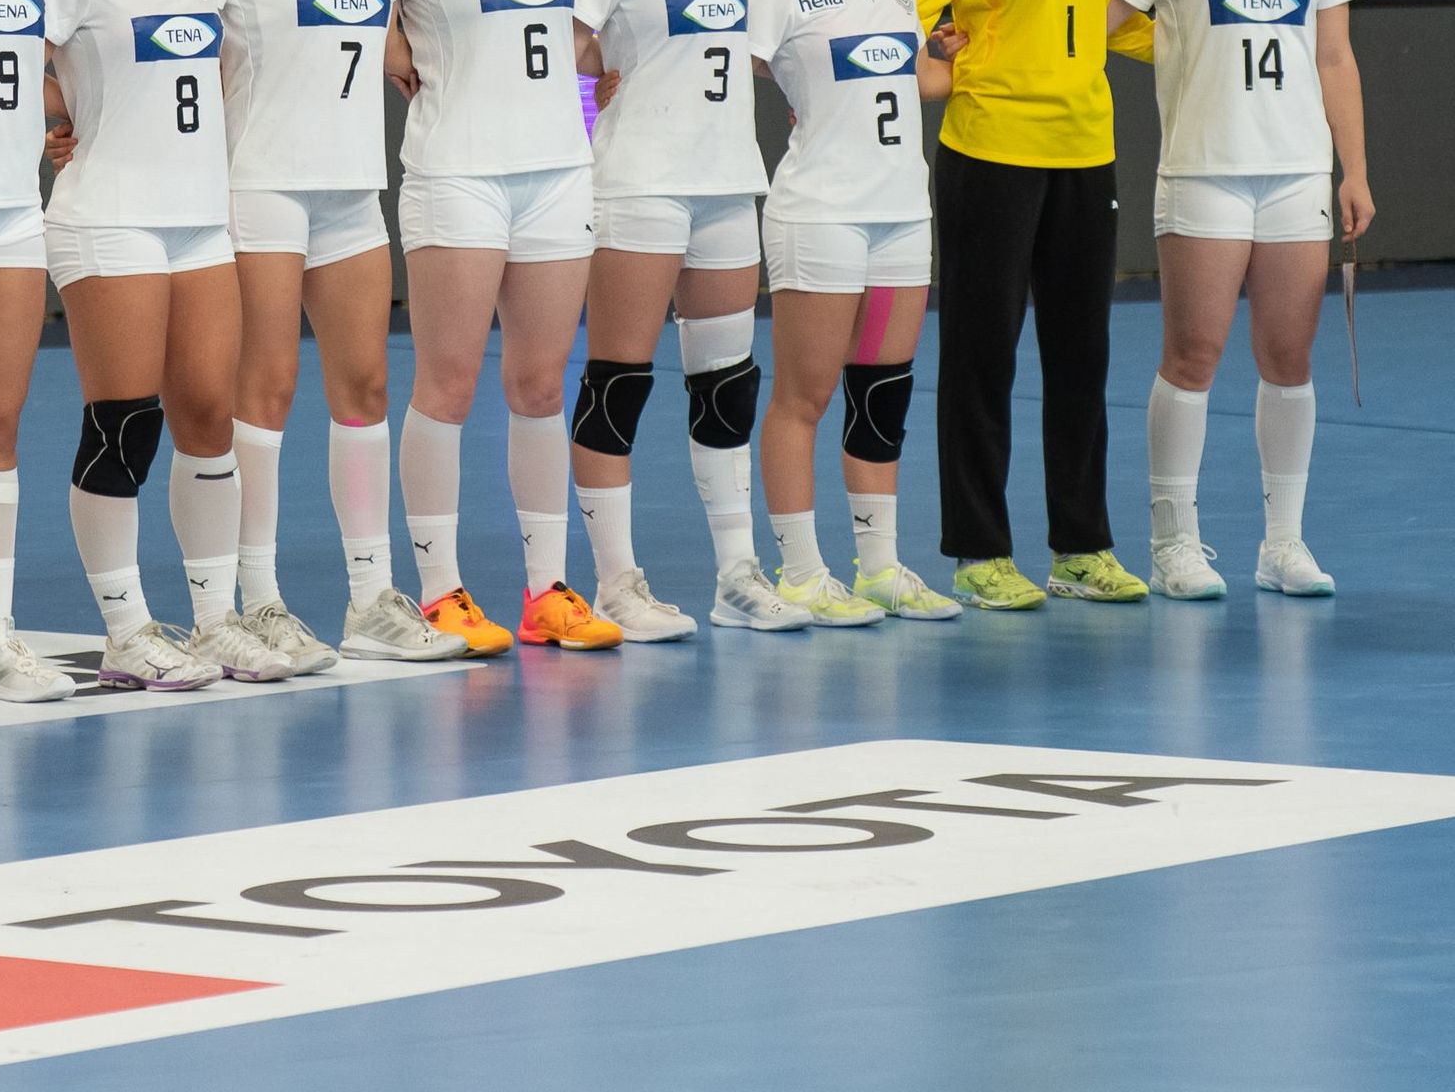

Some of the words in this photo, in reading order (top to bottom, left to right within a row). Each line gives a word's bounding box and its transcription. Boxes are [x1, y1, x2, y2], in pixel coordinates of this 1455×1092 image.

[165, 28, 202, 44] TENA
[697, 3, 736, 18] TENA
[1066, 5, 1076, 58] 1
[340, 40, 363, 99] 7
[523, 23, 549, 80] 6
[704, 46, 731, 102] 3
[862, 46, 900, 62] TENA
[1242, 38, 1284, 91] 14
[176, 74, 200, 134] 8
[875, 91, 902, 146] 2
[1, 772, 1290, 938] TOYOTA
